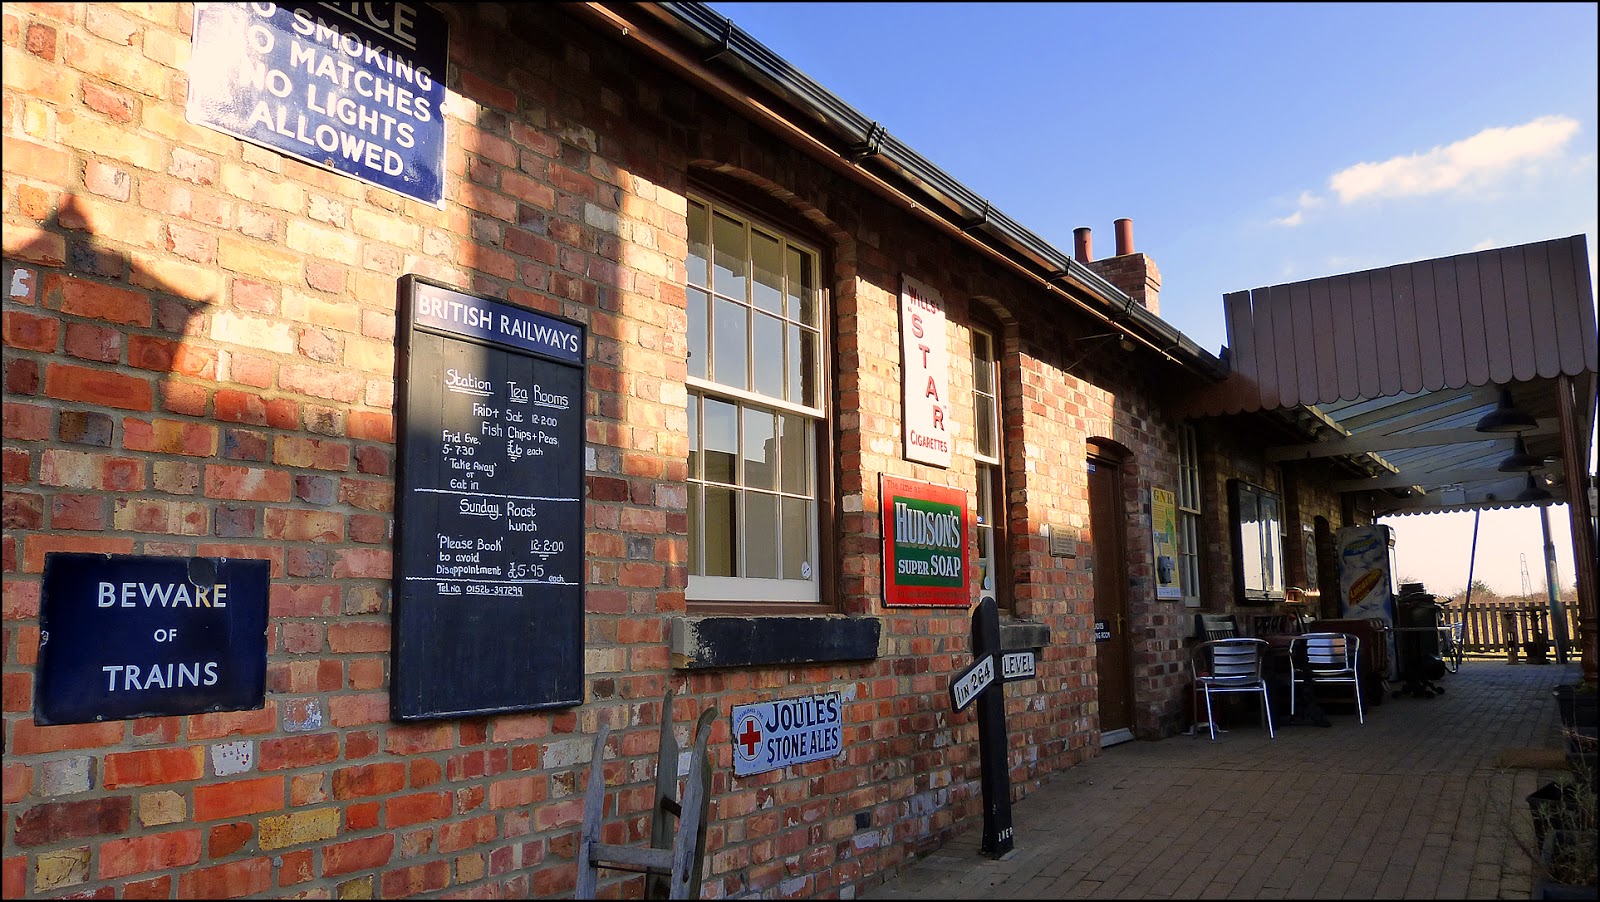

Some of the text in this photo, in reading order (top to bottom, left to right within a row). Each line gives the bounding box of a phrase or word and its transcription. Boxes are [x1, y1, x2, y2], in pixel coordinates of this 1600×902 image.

[291, 7, 432, 92] SMOKING
[290, 39, 432, 123] MATCHES
[307, 83, 415, 149] LIGHTS
[418, 294, 578, 353] BRITISH RAILWAYS
[445, 368, 569, 407] Station Tea Rooms
[506, 409, 523, 422] Sat
[442, 429, 461, 443] Frid
[482, 421, 503, 438] Fish
[910, 429, 948, 453] CIGARETTES
[506, 439, 544, 456] £6 each
[450, 478, 479, 490] Eat in
[466, 471, 475, 479] or
[1153, 489, 1173, 505] GNR
[460, 498, 537, 521] Sunday Roast
[895, 501, 961, 549] HUDSON'S
[439, 552, 480, 563] to avoid
[898, 554, 961, 577] SUPER SOAP
[436, 564, 502, 577] Disappointment
[548, 574, 564, 583] each
[97, 581, 227, 608] BEWARE
[153, 628, 178, 643] OF
[102, 661, 218, 692] TRAINS
[970, 662, 991, 691] 264
[1003, 655, 1034, 675] LEVEL
[766, 727, 839, 764] STONE ALES
